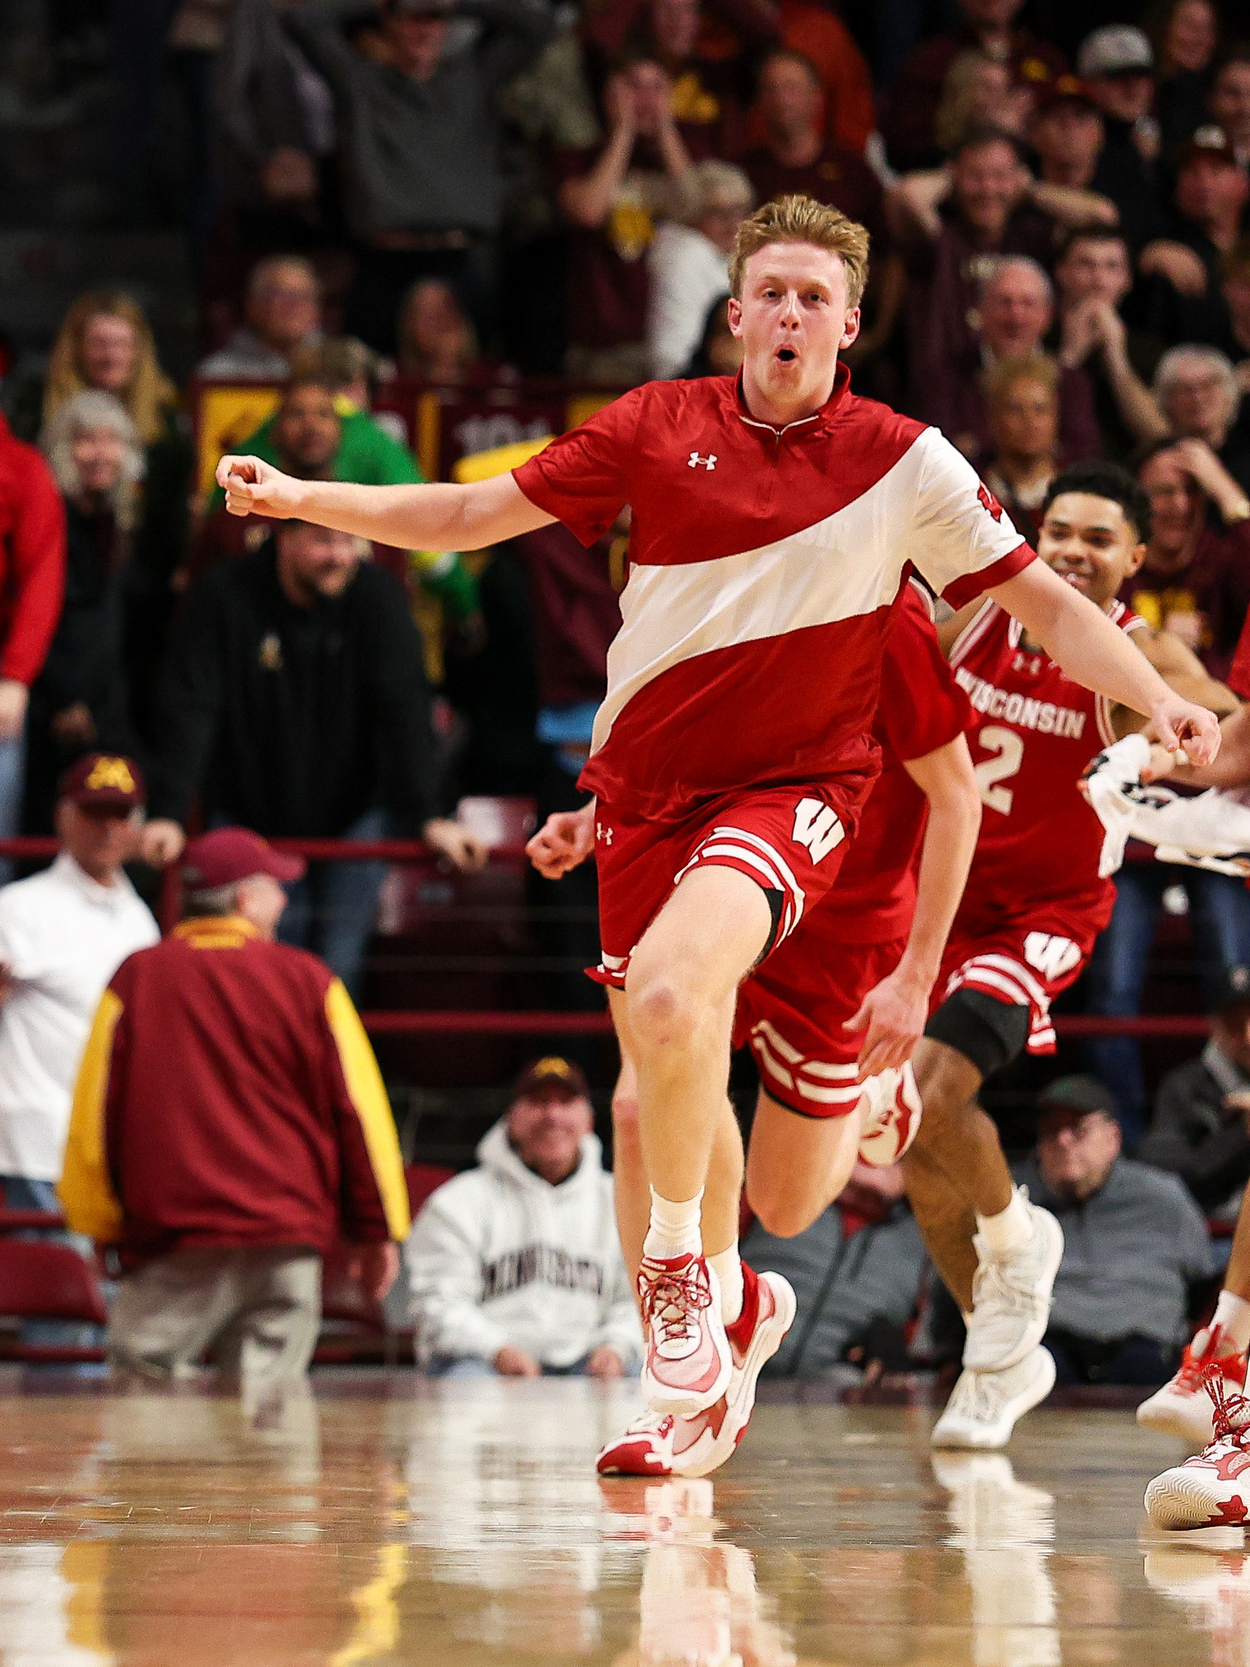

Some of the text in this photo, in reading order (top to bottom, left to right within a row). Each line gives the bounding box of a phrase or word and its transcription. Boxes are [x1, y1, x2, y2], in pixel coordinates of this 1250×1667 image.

[954, 666, 1087, 740] WISCONSIN
[974, 725, 1024, 816] 2
[792, 797, 846, 866] W
[1023, 931, 1082, 981] W
